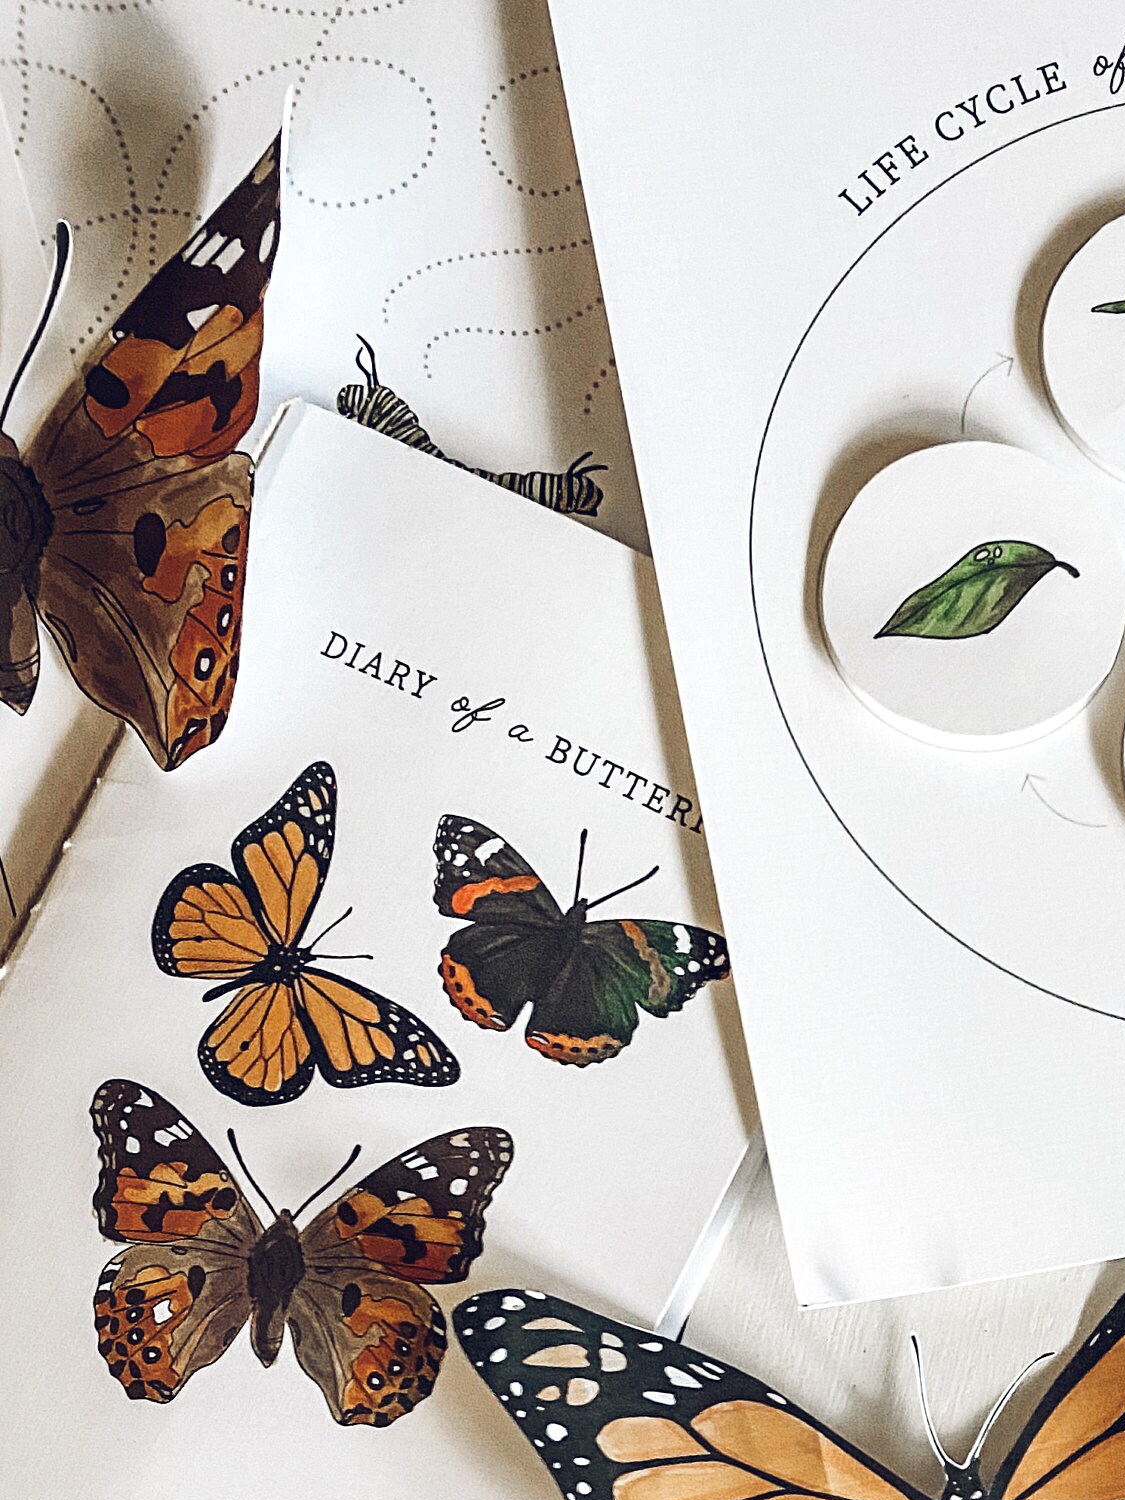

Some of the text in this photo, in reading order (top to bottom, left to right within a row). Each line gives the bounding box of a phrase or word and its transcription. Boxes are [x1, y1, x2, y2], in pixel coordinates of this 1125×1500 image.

[838, 134, 930, 217] LIFE
[934, 61, 1067, 141] CYCLE
[320, 630, 438, 699] DIARY
[450, 696, 506, 733] of
[508, 724, 534, 743] a
